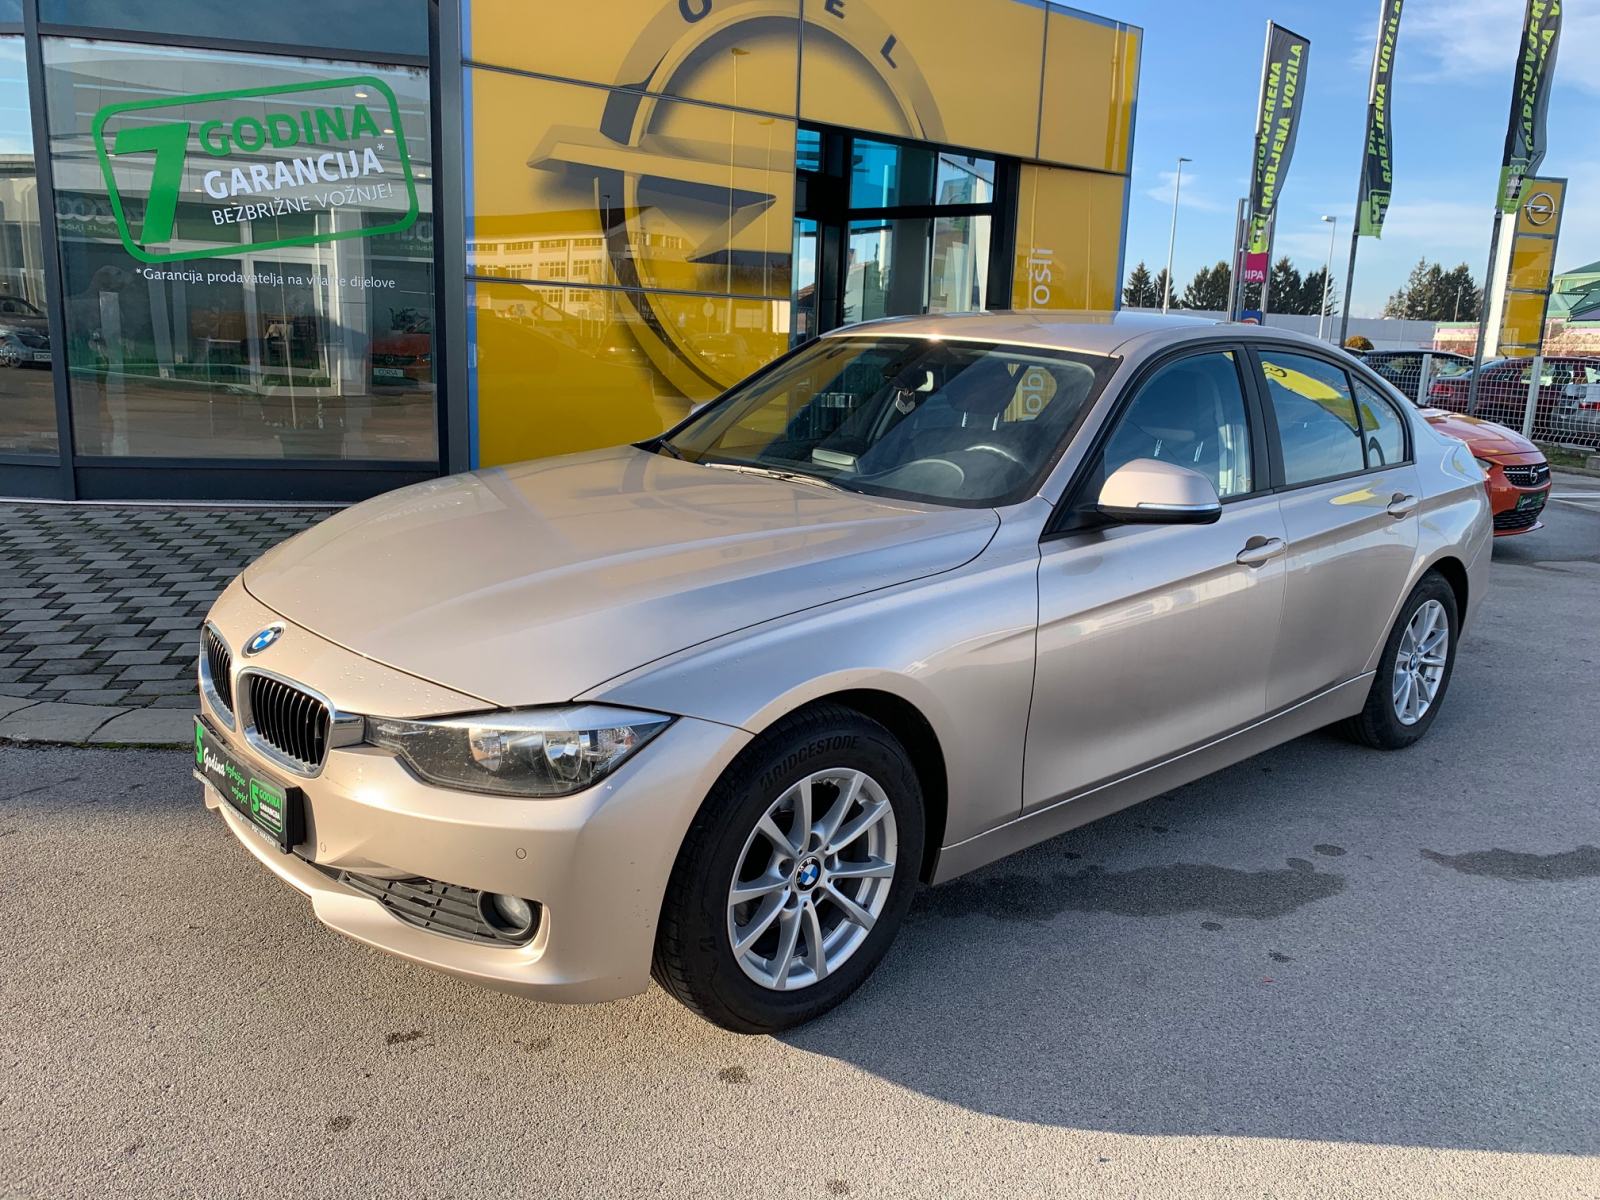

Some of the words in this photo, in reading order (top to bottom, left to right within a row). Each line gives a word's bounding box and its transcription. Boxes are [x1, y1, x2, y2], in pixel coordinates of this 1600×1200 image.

[1261, 117, 1290, 208] RABLJENA
[1281, 44, 1303, 109] VOZILA
[113, 121, 191, 246] 7
[200, 103, 381, 157] GODINA
[211, 195, 312, 226] BEZBRIŽNE
[314, 182, 393, 209] VOŽNJE!
[207, 271, 284, 287] prodavatelja
[287, 275, 303, 286] na
[350, 274, 396, 290] dijelove
[1028, 247, 1053, 305] ošli
[195, 720, 204, 764] 5
[203, 747, 226, 777] Godina
[252, 783, 259, 812] 5
